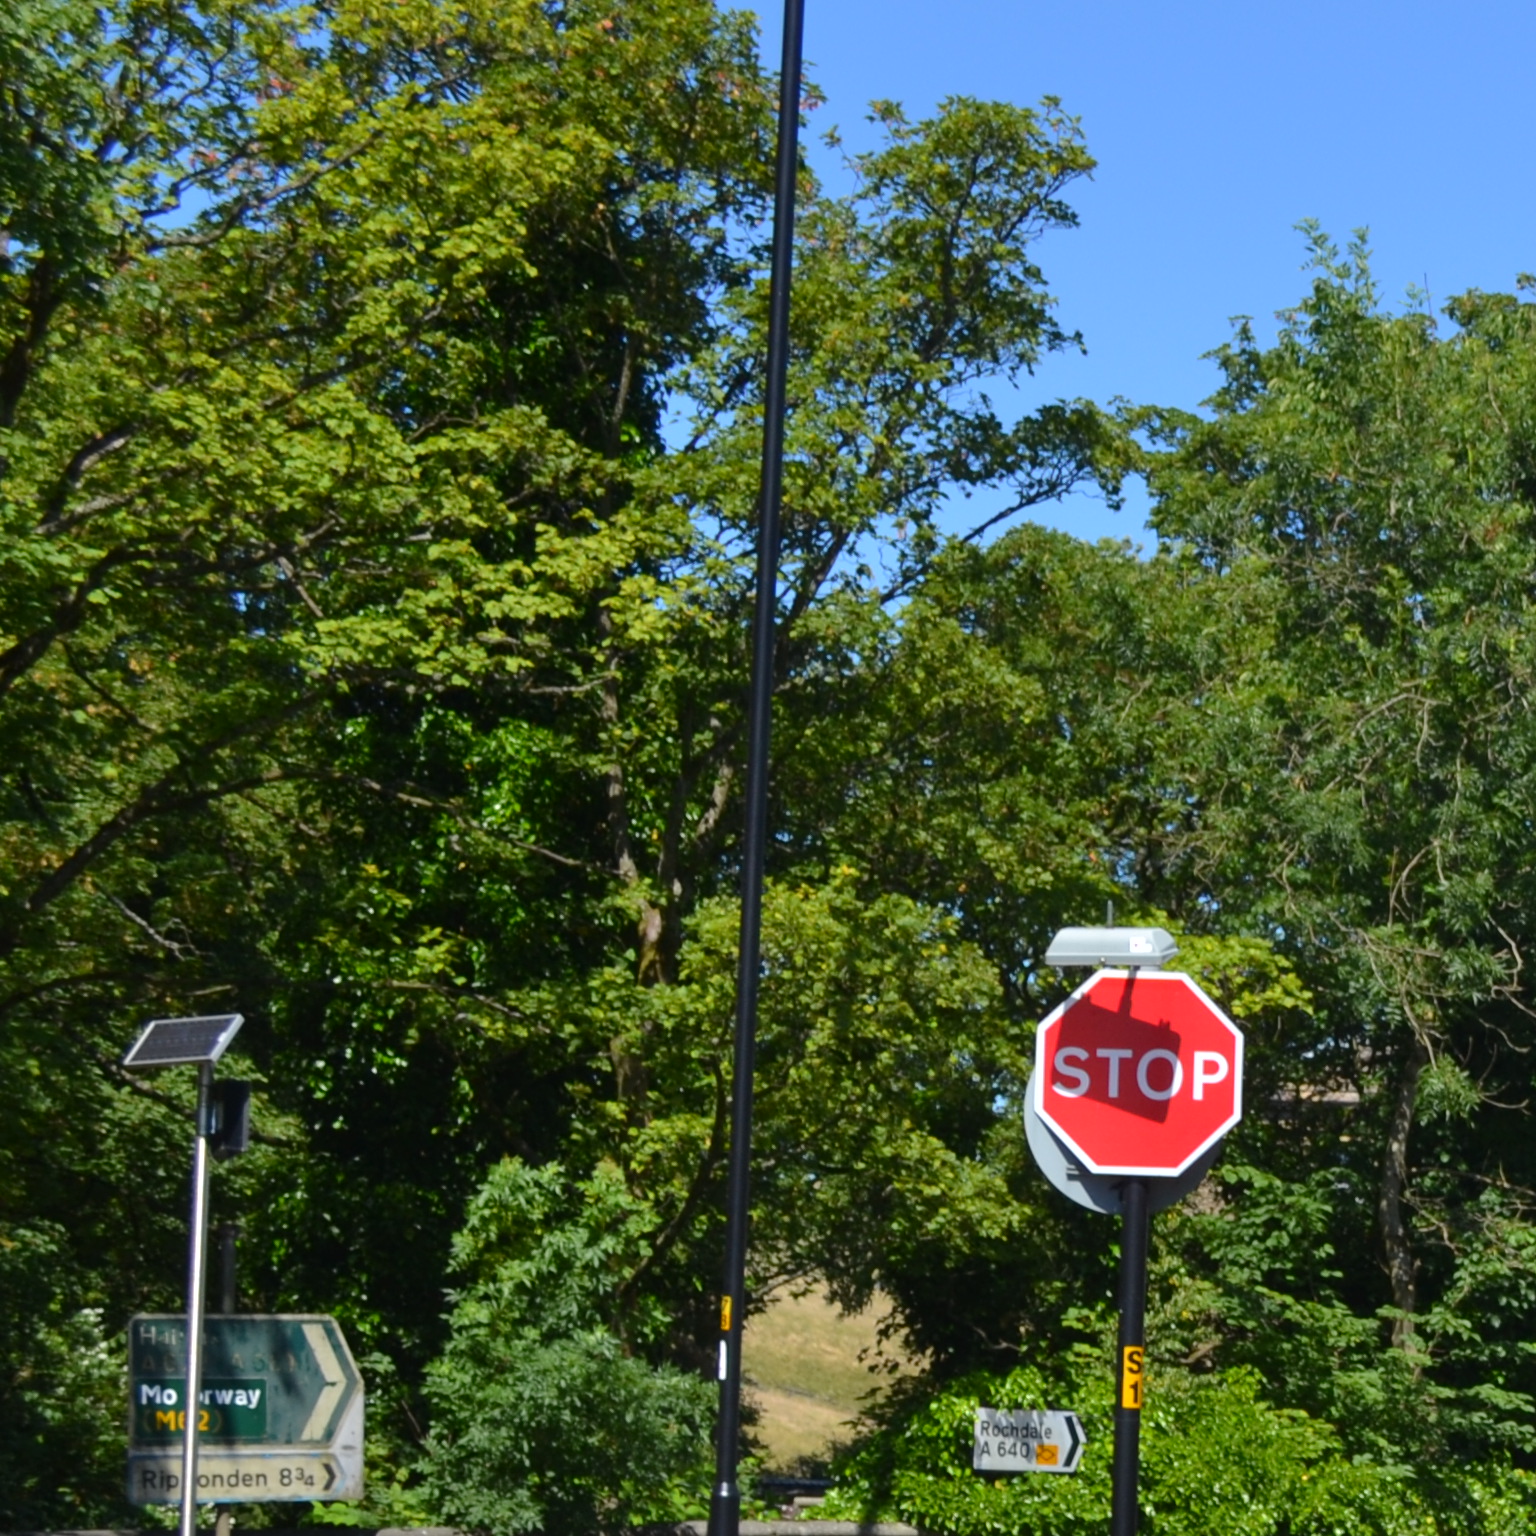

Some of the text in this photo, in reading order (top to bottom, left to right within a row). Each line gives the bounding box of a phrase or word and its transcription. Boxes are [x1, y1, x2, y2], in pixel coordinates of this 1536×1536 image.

[1052, 1046, 1229, 1101] STOP
[980, 1420, 1052, 1440] Rochdale
[979, 1441, 1030, 1459] A 640
[142, 1470, 267, 1492] Riponden
